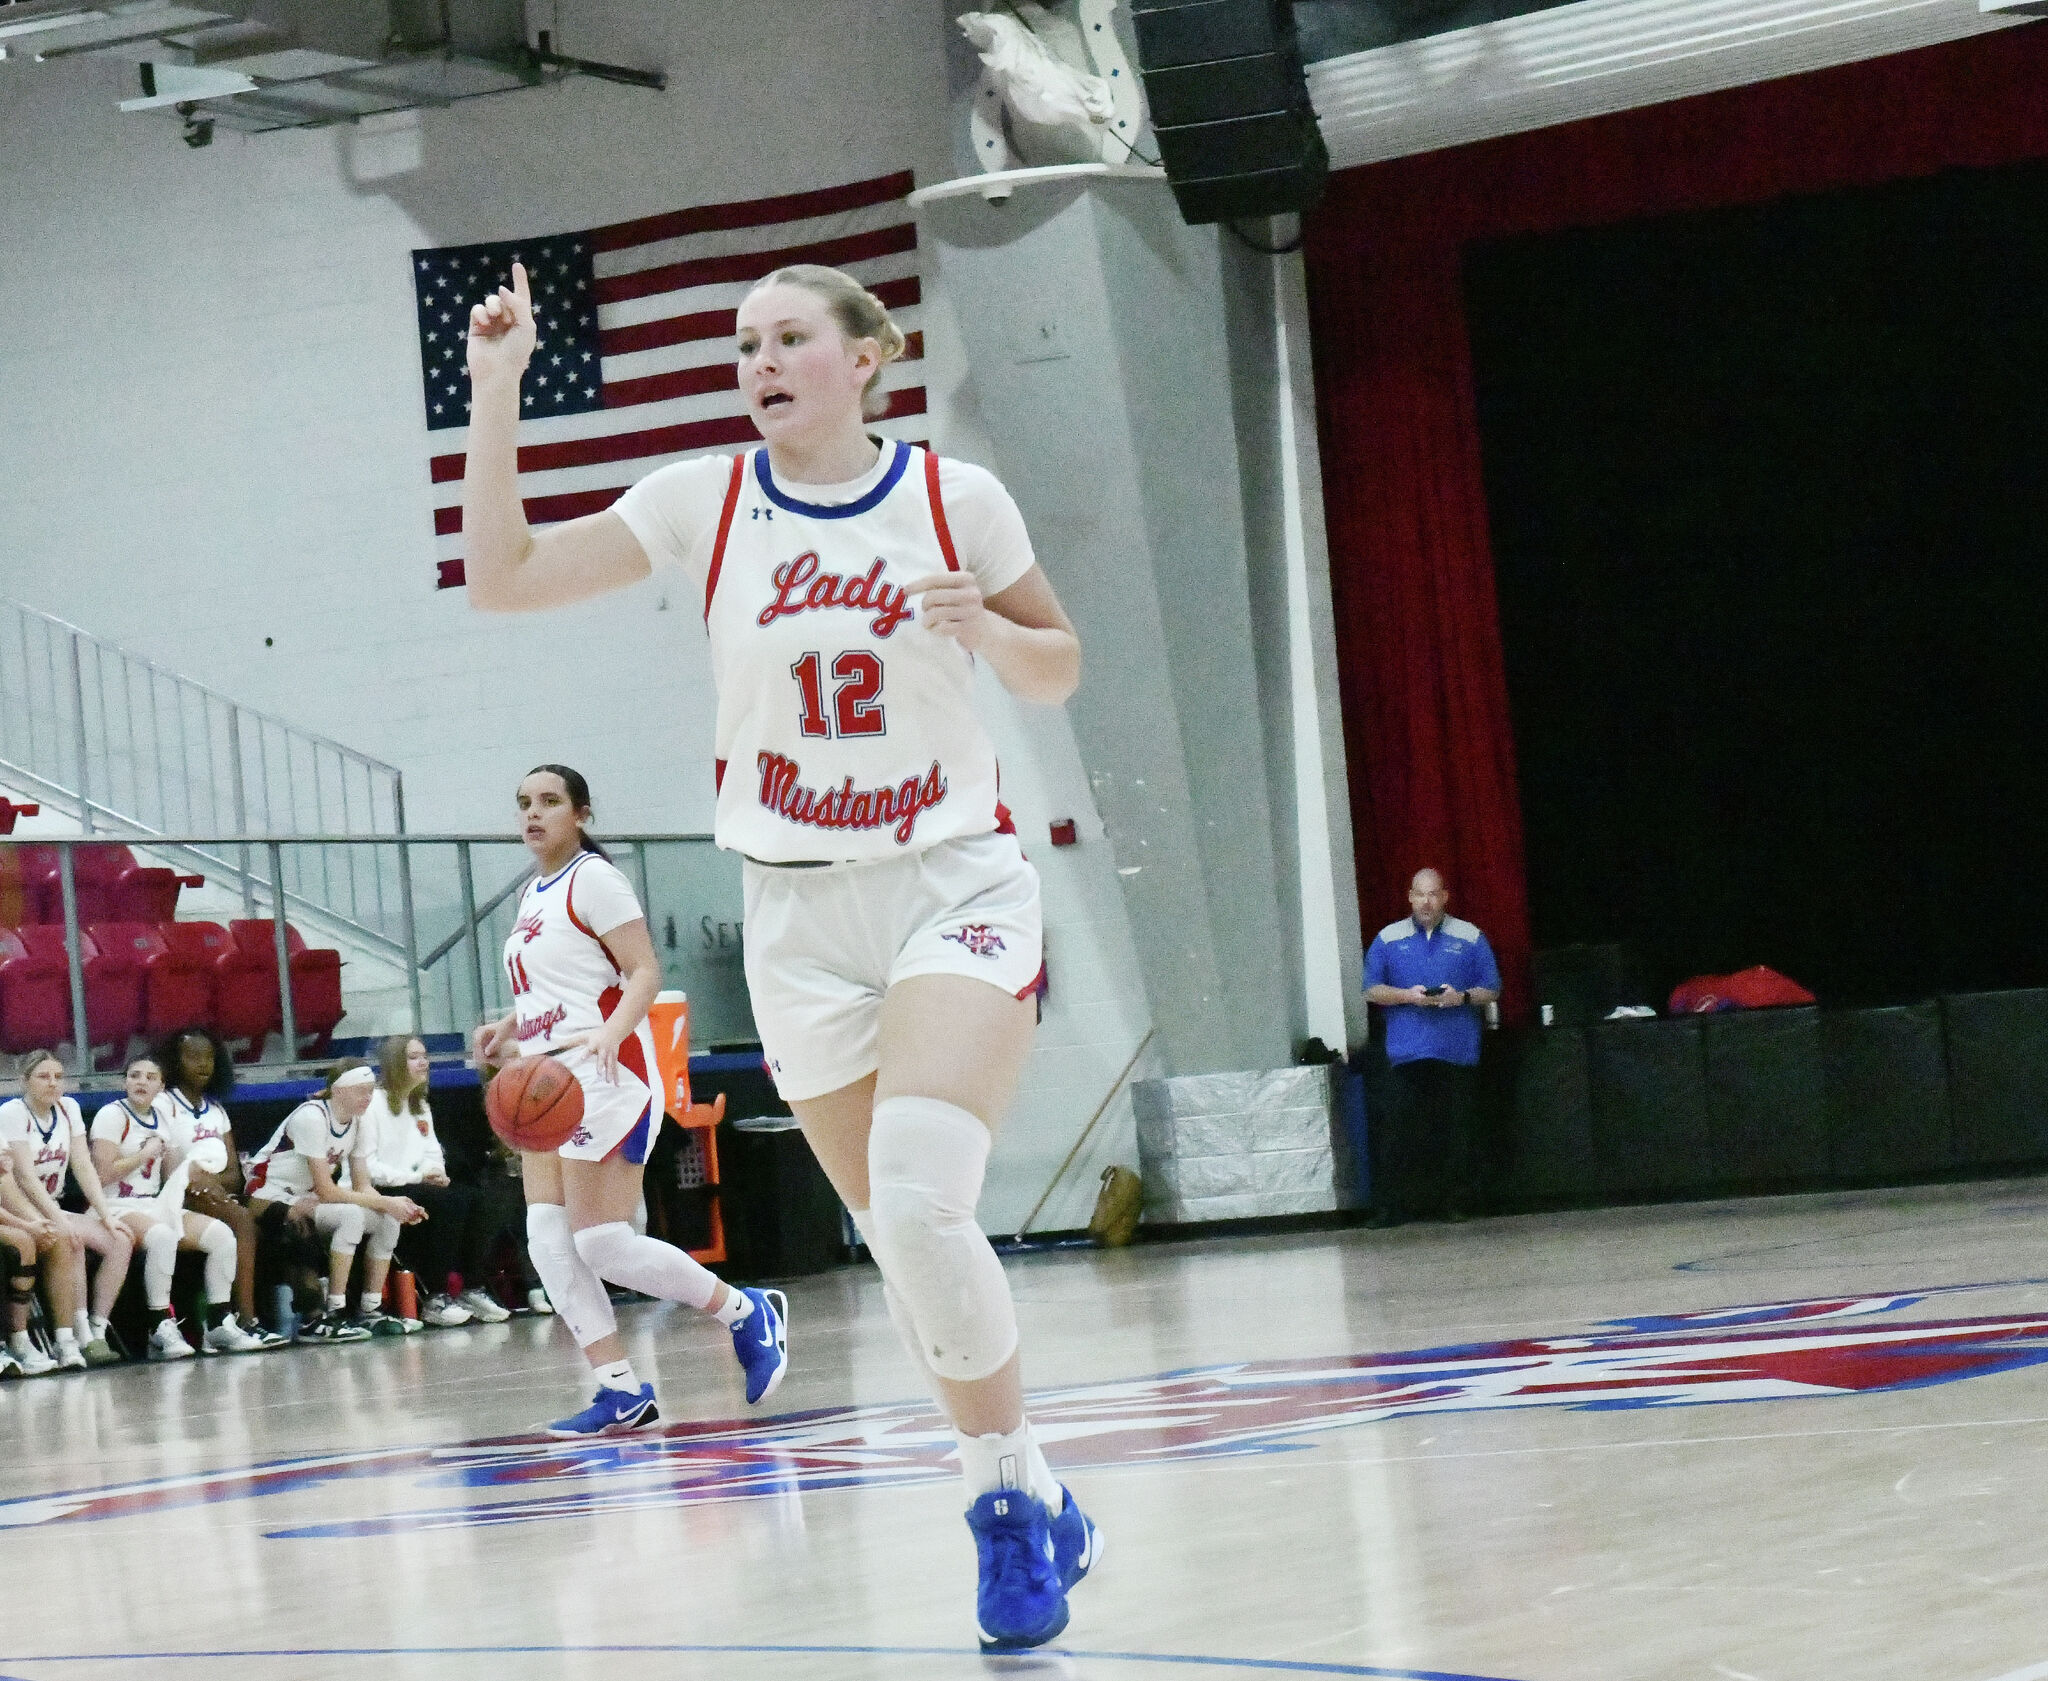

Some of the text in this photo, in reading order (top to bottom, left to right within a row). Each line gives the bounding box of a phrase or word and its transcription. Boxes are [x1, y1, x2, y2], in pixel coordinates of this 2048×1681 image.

[756, 550, 914, 638] Lady
[790, 650, 886, 739] 12
[756, 750, 949, 846] Mustangs
[511, 908, 544, 943] ady
